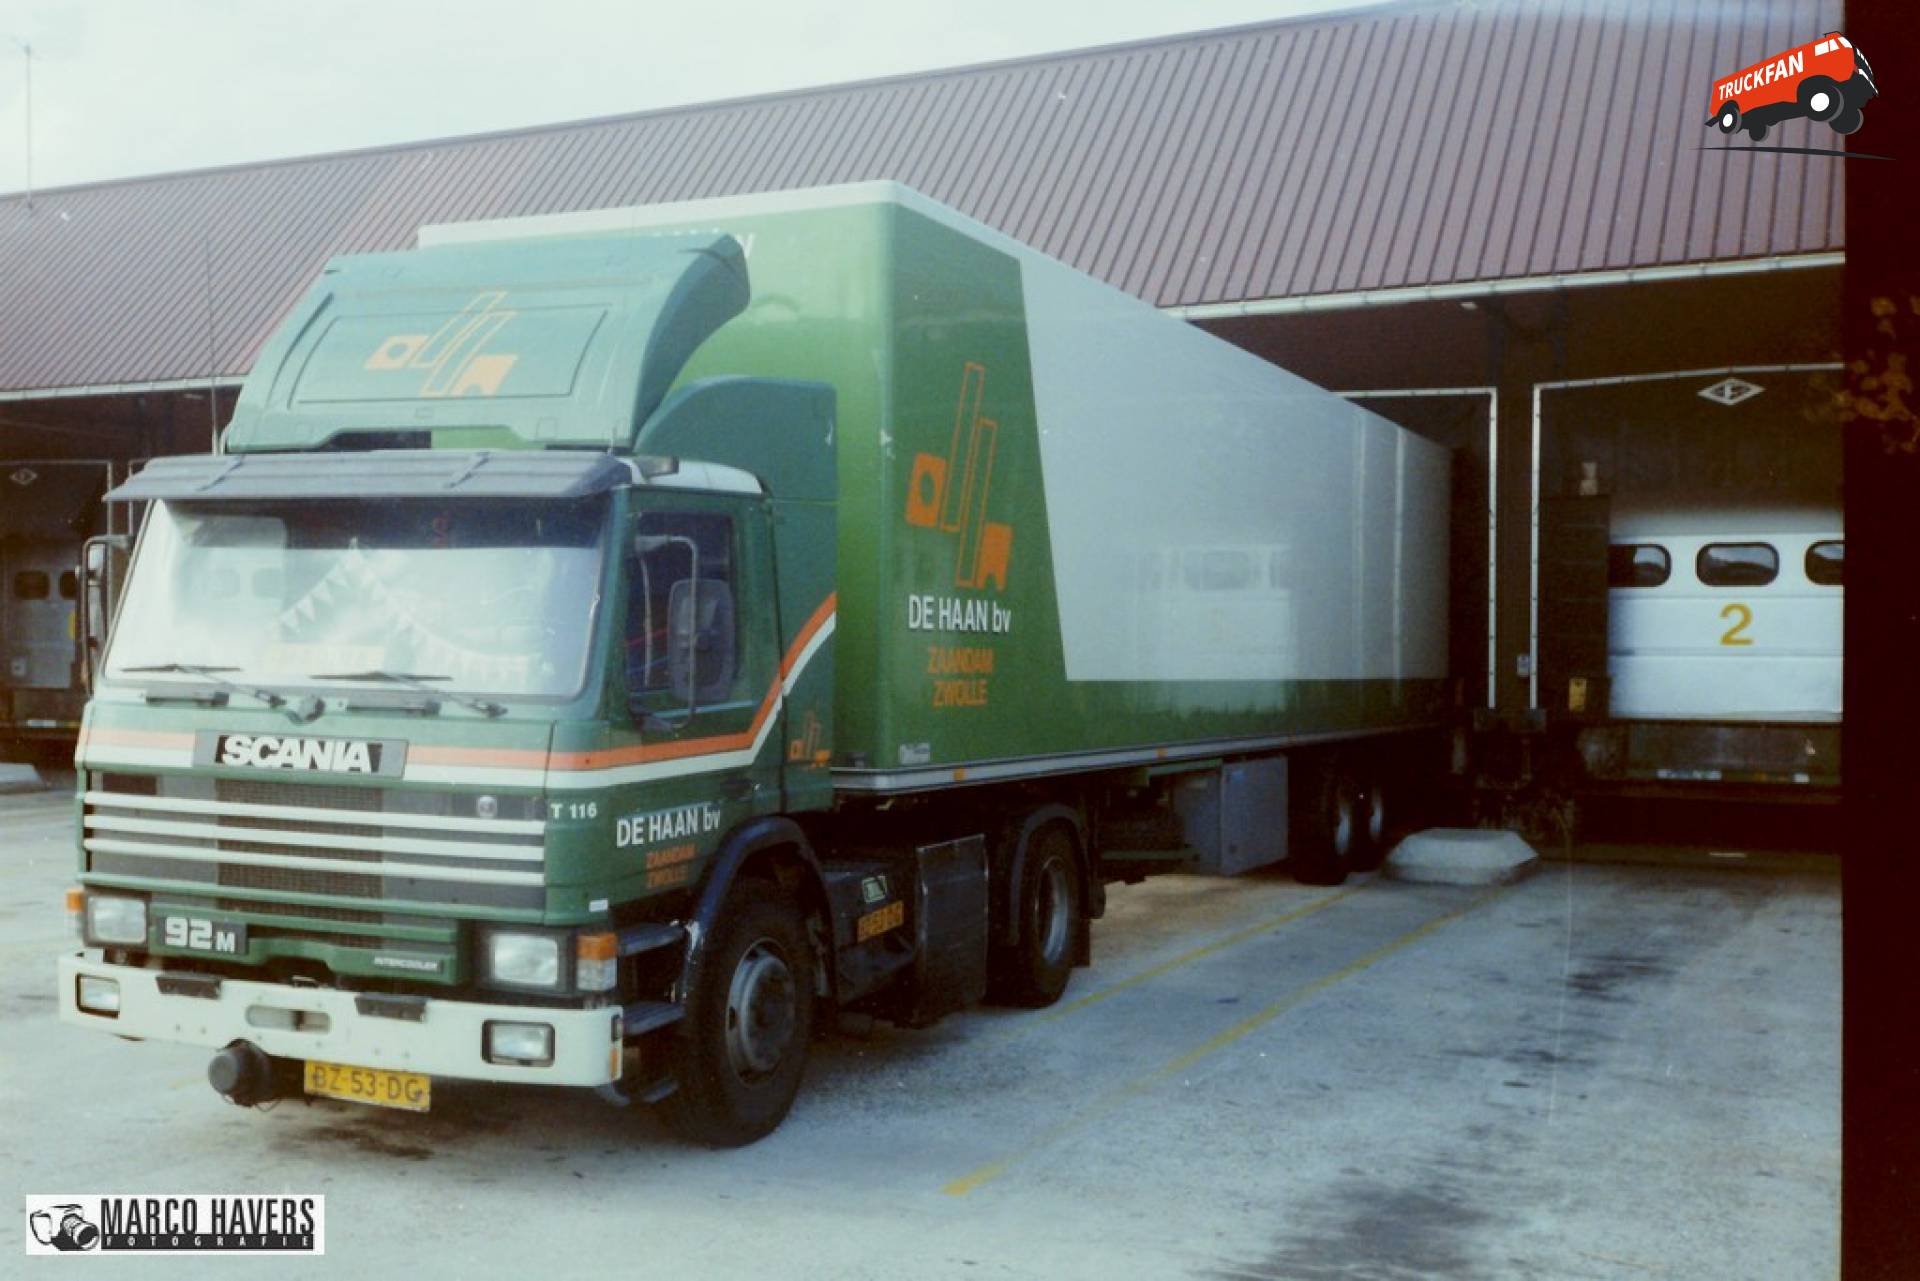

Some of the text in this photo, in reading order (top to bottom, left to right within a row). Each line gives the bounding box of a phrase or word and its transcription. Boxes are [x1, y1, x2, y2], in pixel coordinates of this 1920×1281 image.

[909, 594, 1012, 633] DE HAAN bv
[1719, 603, 1754, 645] 2
[928, 646, 994, 673] ZAANDAM
[933, 679, 988, 709] ZWOLLE
[222, 735, 372, 773] SCANIA
[550, 802, 597, 819] T 116
[616, 805, 721, 848] DE HAAN bv
[311, 1065, 423, 1101] BZ-53-DG
